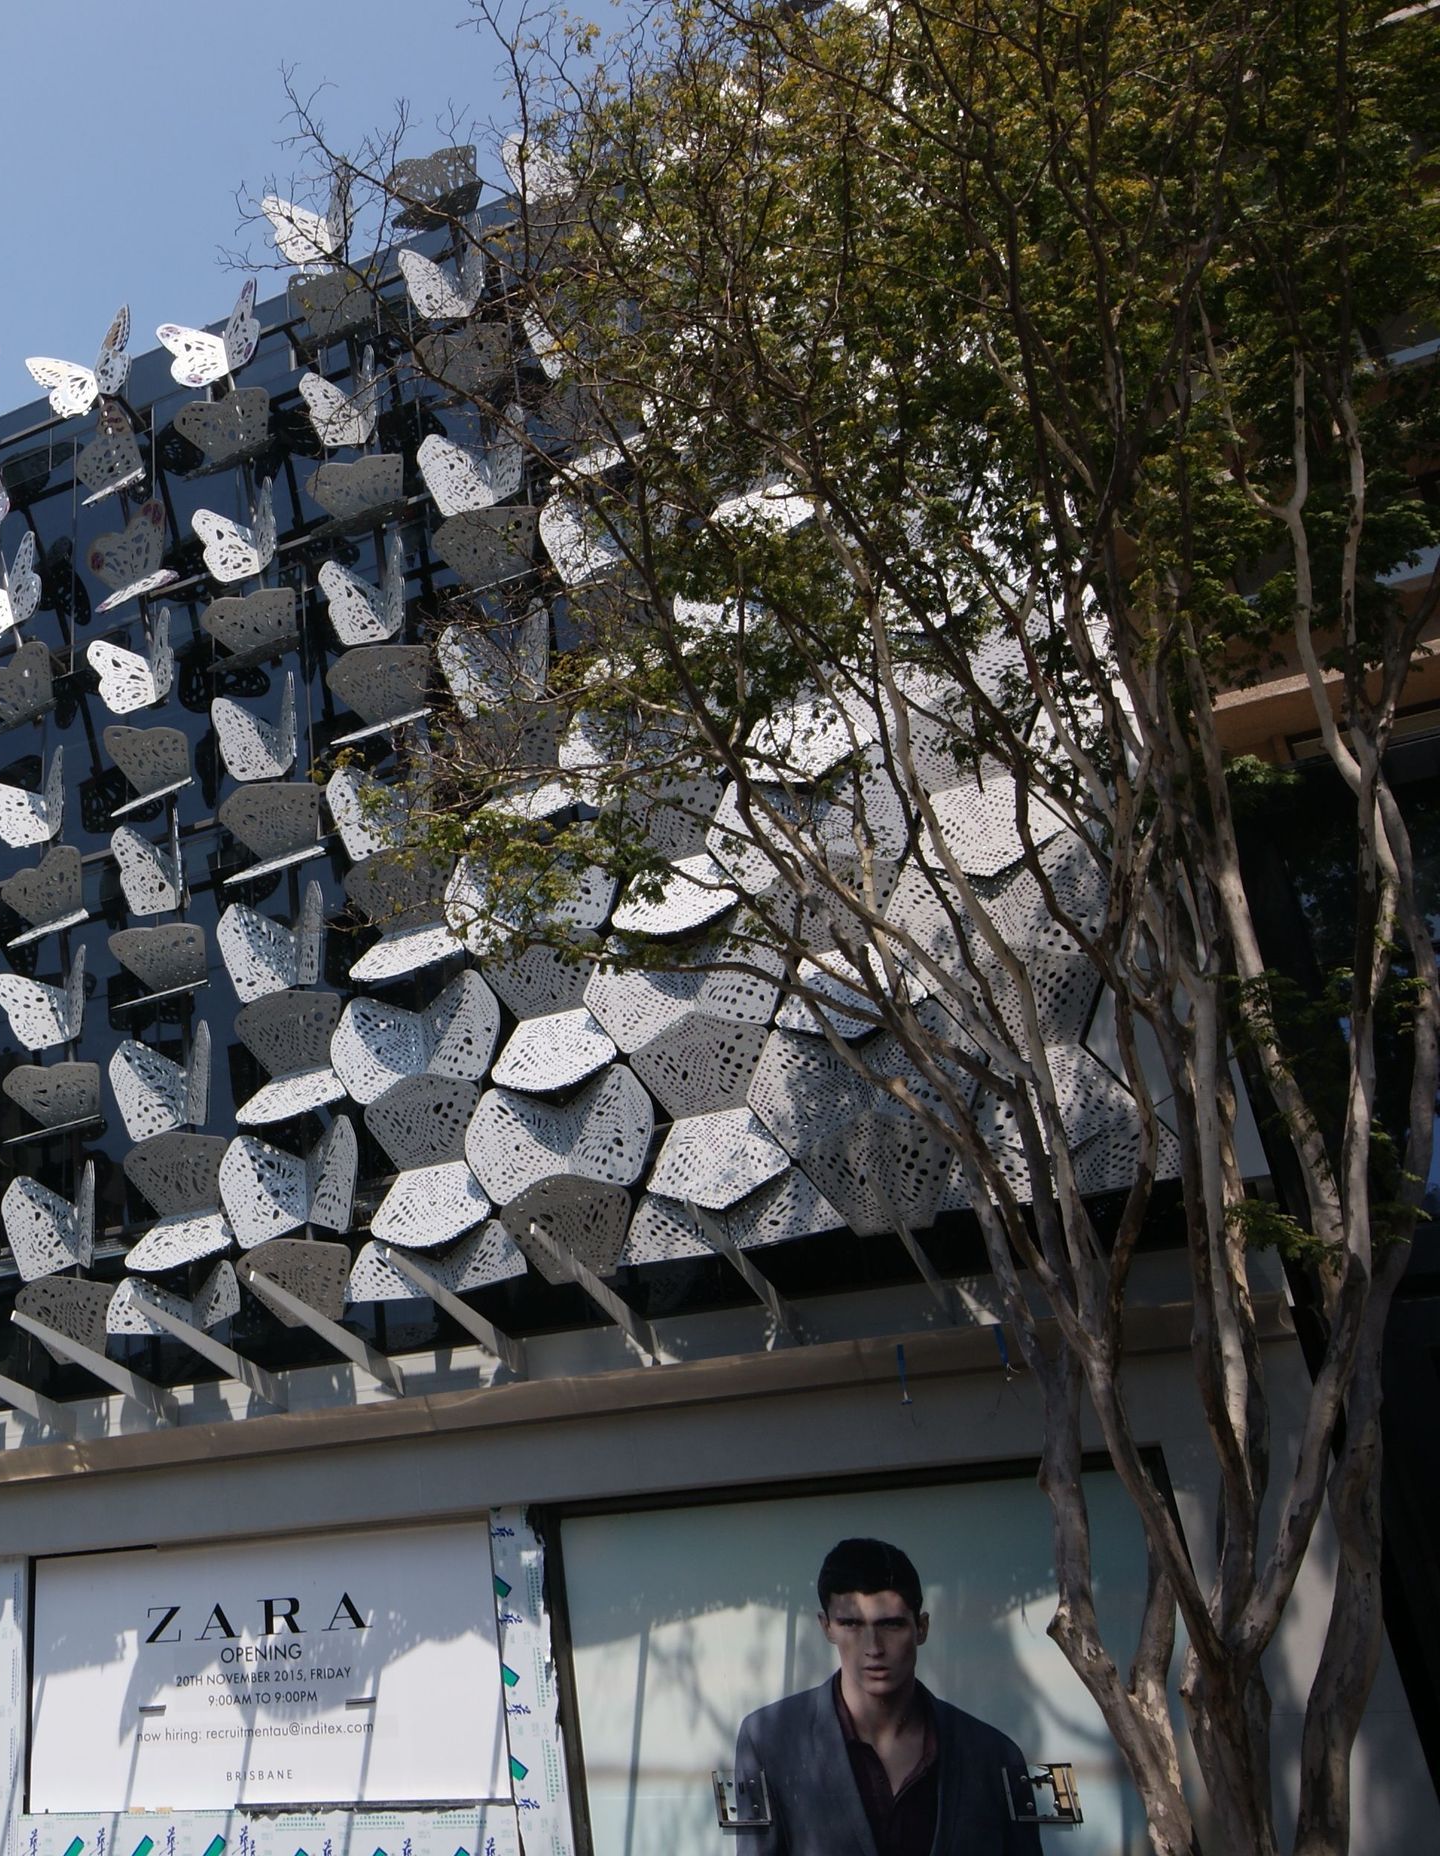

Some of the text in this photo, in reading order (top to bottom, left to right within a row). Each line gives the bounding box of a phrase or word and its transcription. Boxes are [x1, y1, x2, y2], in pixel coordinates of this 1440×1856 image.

[145, 1591, 374, 1644] ZARA
[220, 1643, 303, 1664] OPENING
[176, 1667, 352, 1687] 20TH NOVEMBER 2015, FRIDAY
[208, 1691, 318, 1707] 9:00AM TO 9:00PM
[136, 1721, 374, 1744] now hiring: recruitmentau@inditex.com
[226, 1769, 294, 1782] BRISBANE
